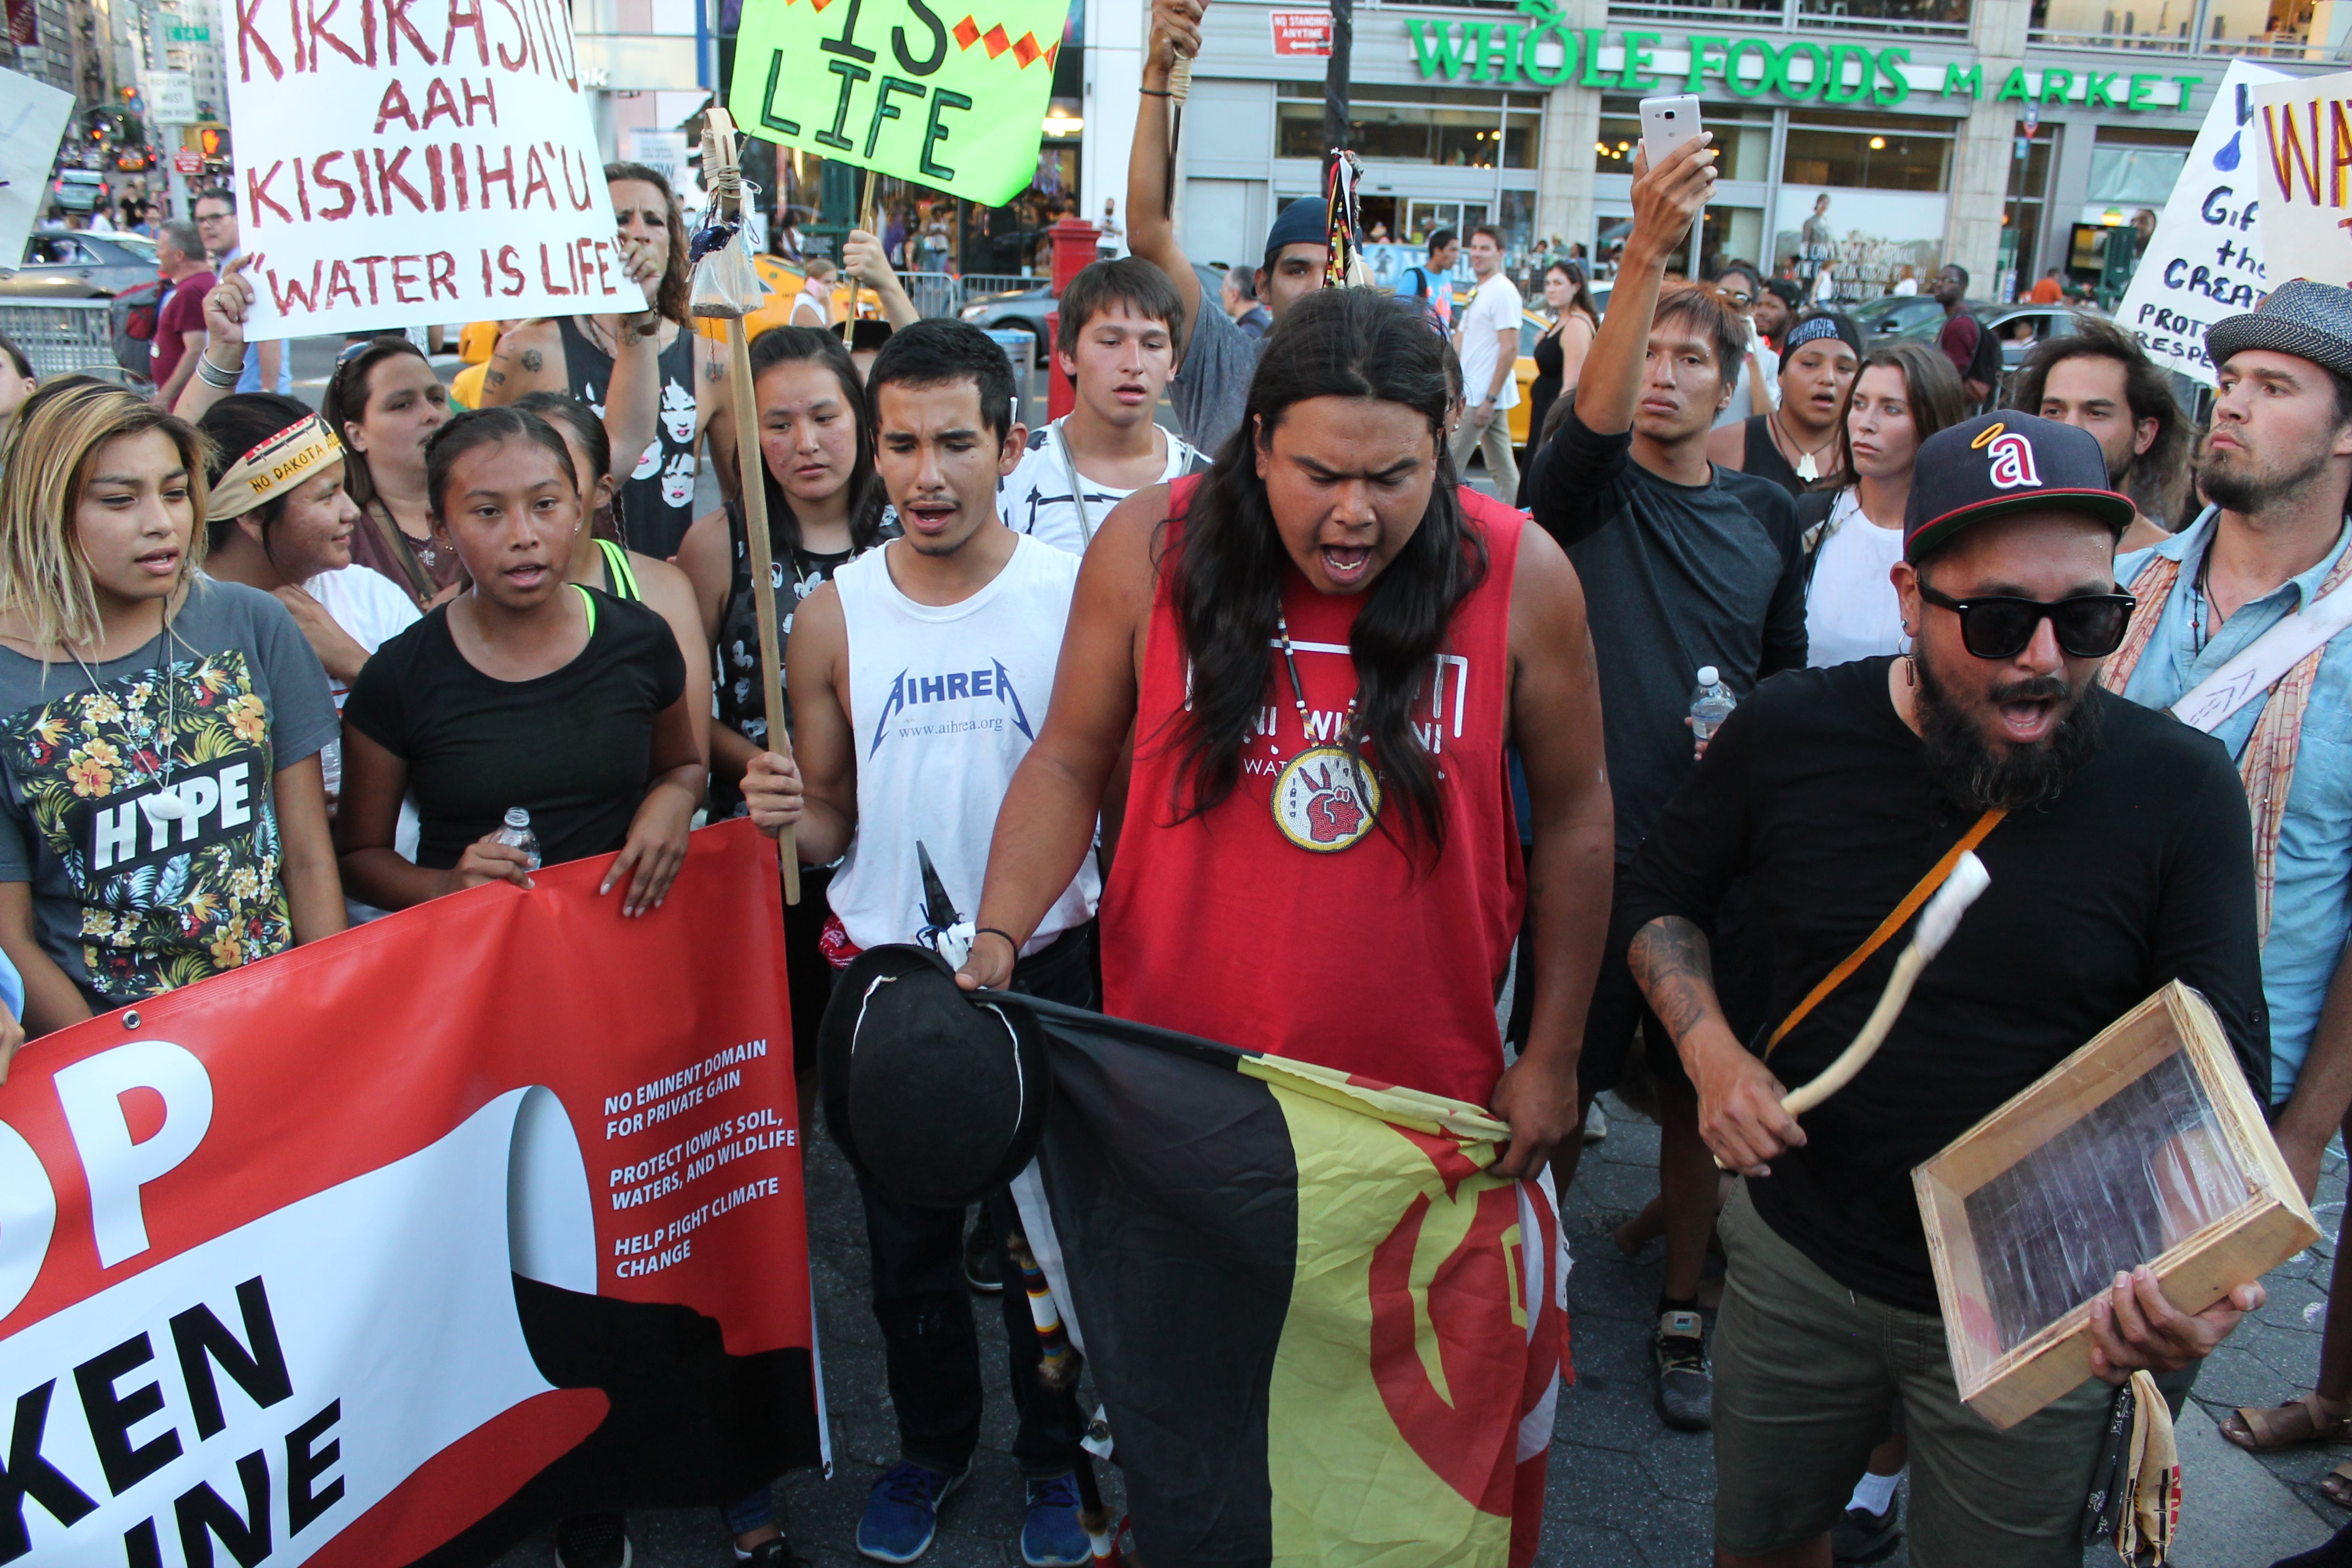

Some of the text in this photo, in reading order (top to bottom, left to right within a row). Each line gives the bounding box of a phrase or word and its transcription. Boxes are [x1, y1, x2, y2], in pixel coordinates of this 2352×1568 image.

[181, 28, 197, 40] 14
[820, 0, 947, 75] IS
[1273, 15, 1329, 27] NO STANDING
[1282, 28, 1323, 39] ANYTIME
[1404, 19, 1661, 89] WHOLE
[1685, 35, 1910, 106] FOODS
[1942, 63, 2202, 112] MARKET
[373, 77, 497, 134] AAH
[761, 48, 972, 181] LIFE
[2262, 97, 2352, 209] WA
[480, 245, 525, 297] IS
[2164, 258, 2268, 309] CREAT
[2137, 303, 2212, 339] PROT
[2136, 331, 2213, 371] RESPE
[249, 474, 272, 493] NO
[273, 443, 325, 481] DAKOTA
[869, 656, 1034, 763] AIHREA
[899, 716, 1003, 738] www.aihrea.org
[1244, 758, 1288, 777] WAT
[95, 762, 250, 870] HYPE
[605, 1039, 766, 1116] NO EMINENT DOMAIN
[606, 1070, 741, 1140] FOR PRIVATE GAIN
[609, 1108, 783, 1188] PROTECT IOWA'S SOIL,
[612, 1129, 795, 1210] WATERS, AND WILDLIFE
[614, 1177, 779, 1257] HELP FIGHT CLIMATE
[616, 1239, 692, 1278] CHANGE
